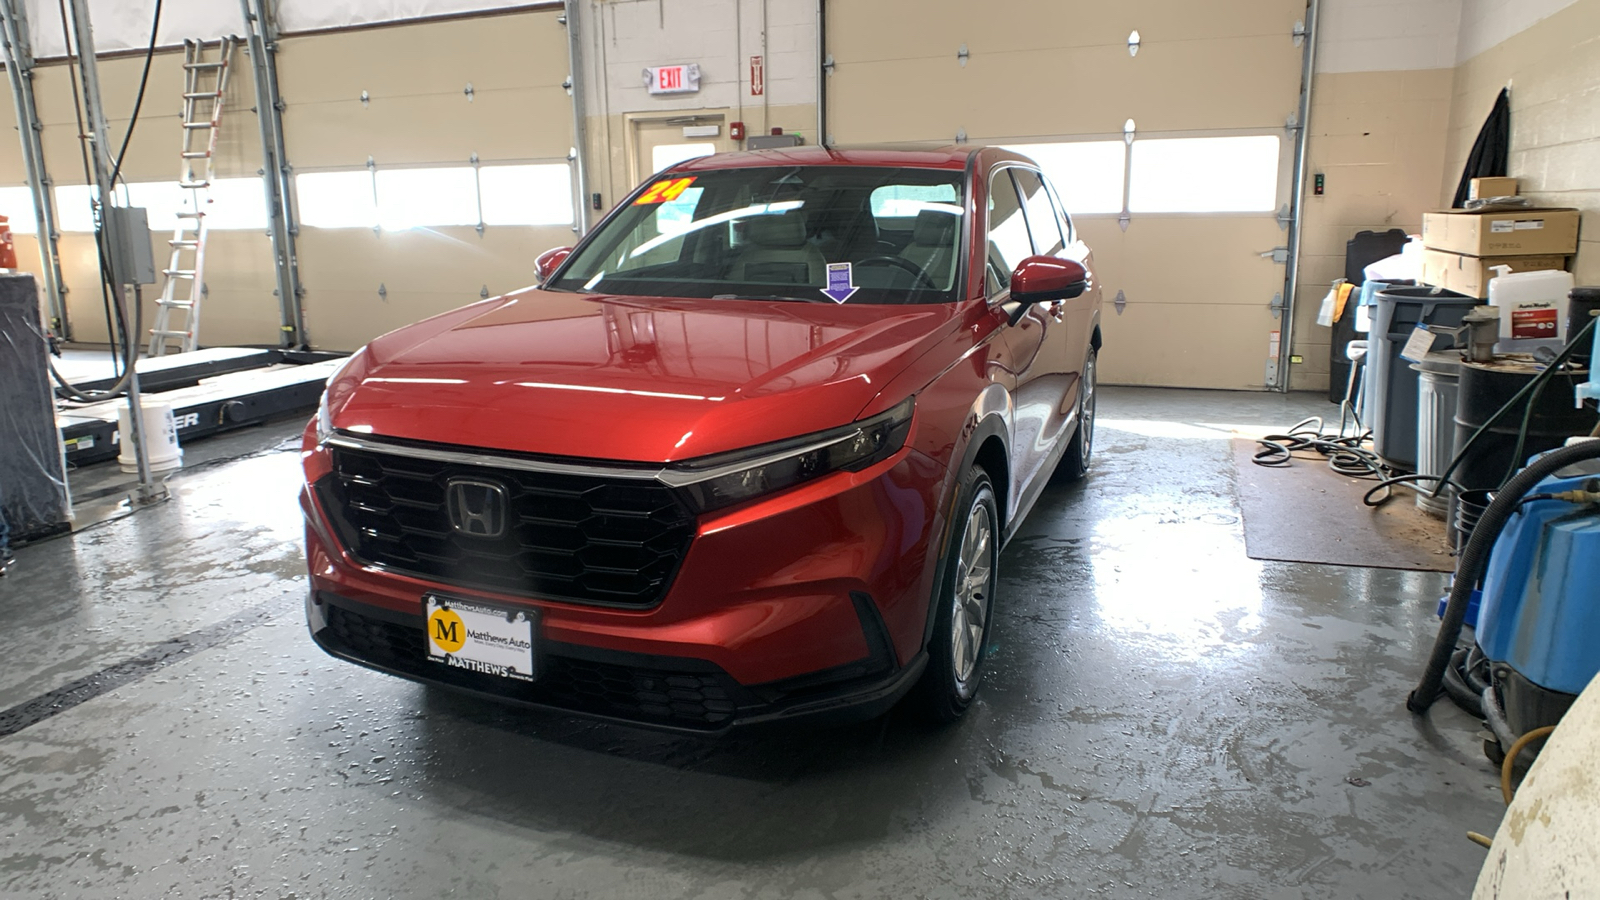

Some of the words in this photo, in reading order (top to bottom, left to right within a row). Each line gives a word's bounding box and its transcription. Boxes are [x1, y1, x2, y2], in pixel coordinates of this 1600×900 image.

[659, 67, 682, 89] EXIT
[636, 178, 691, 204] 24
[444, 600, 508, 618] MatthewsAuto.com
[434, 618, 459, 643] M
[467, 628, 508, 645] Matthews
[508, 637, 531, 649] Auto
[448, 656, 508, 677] MATTHEWS
